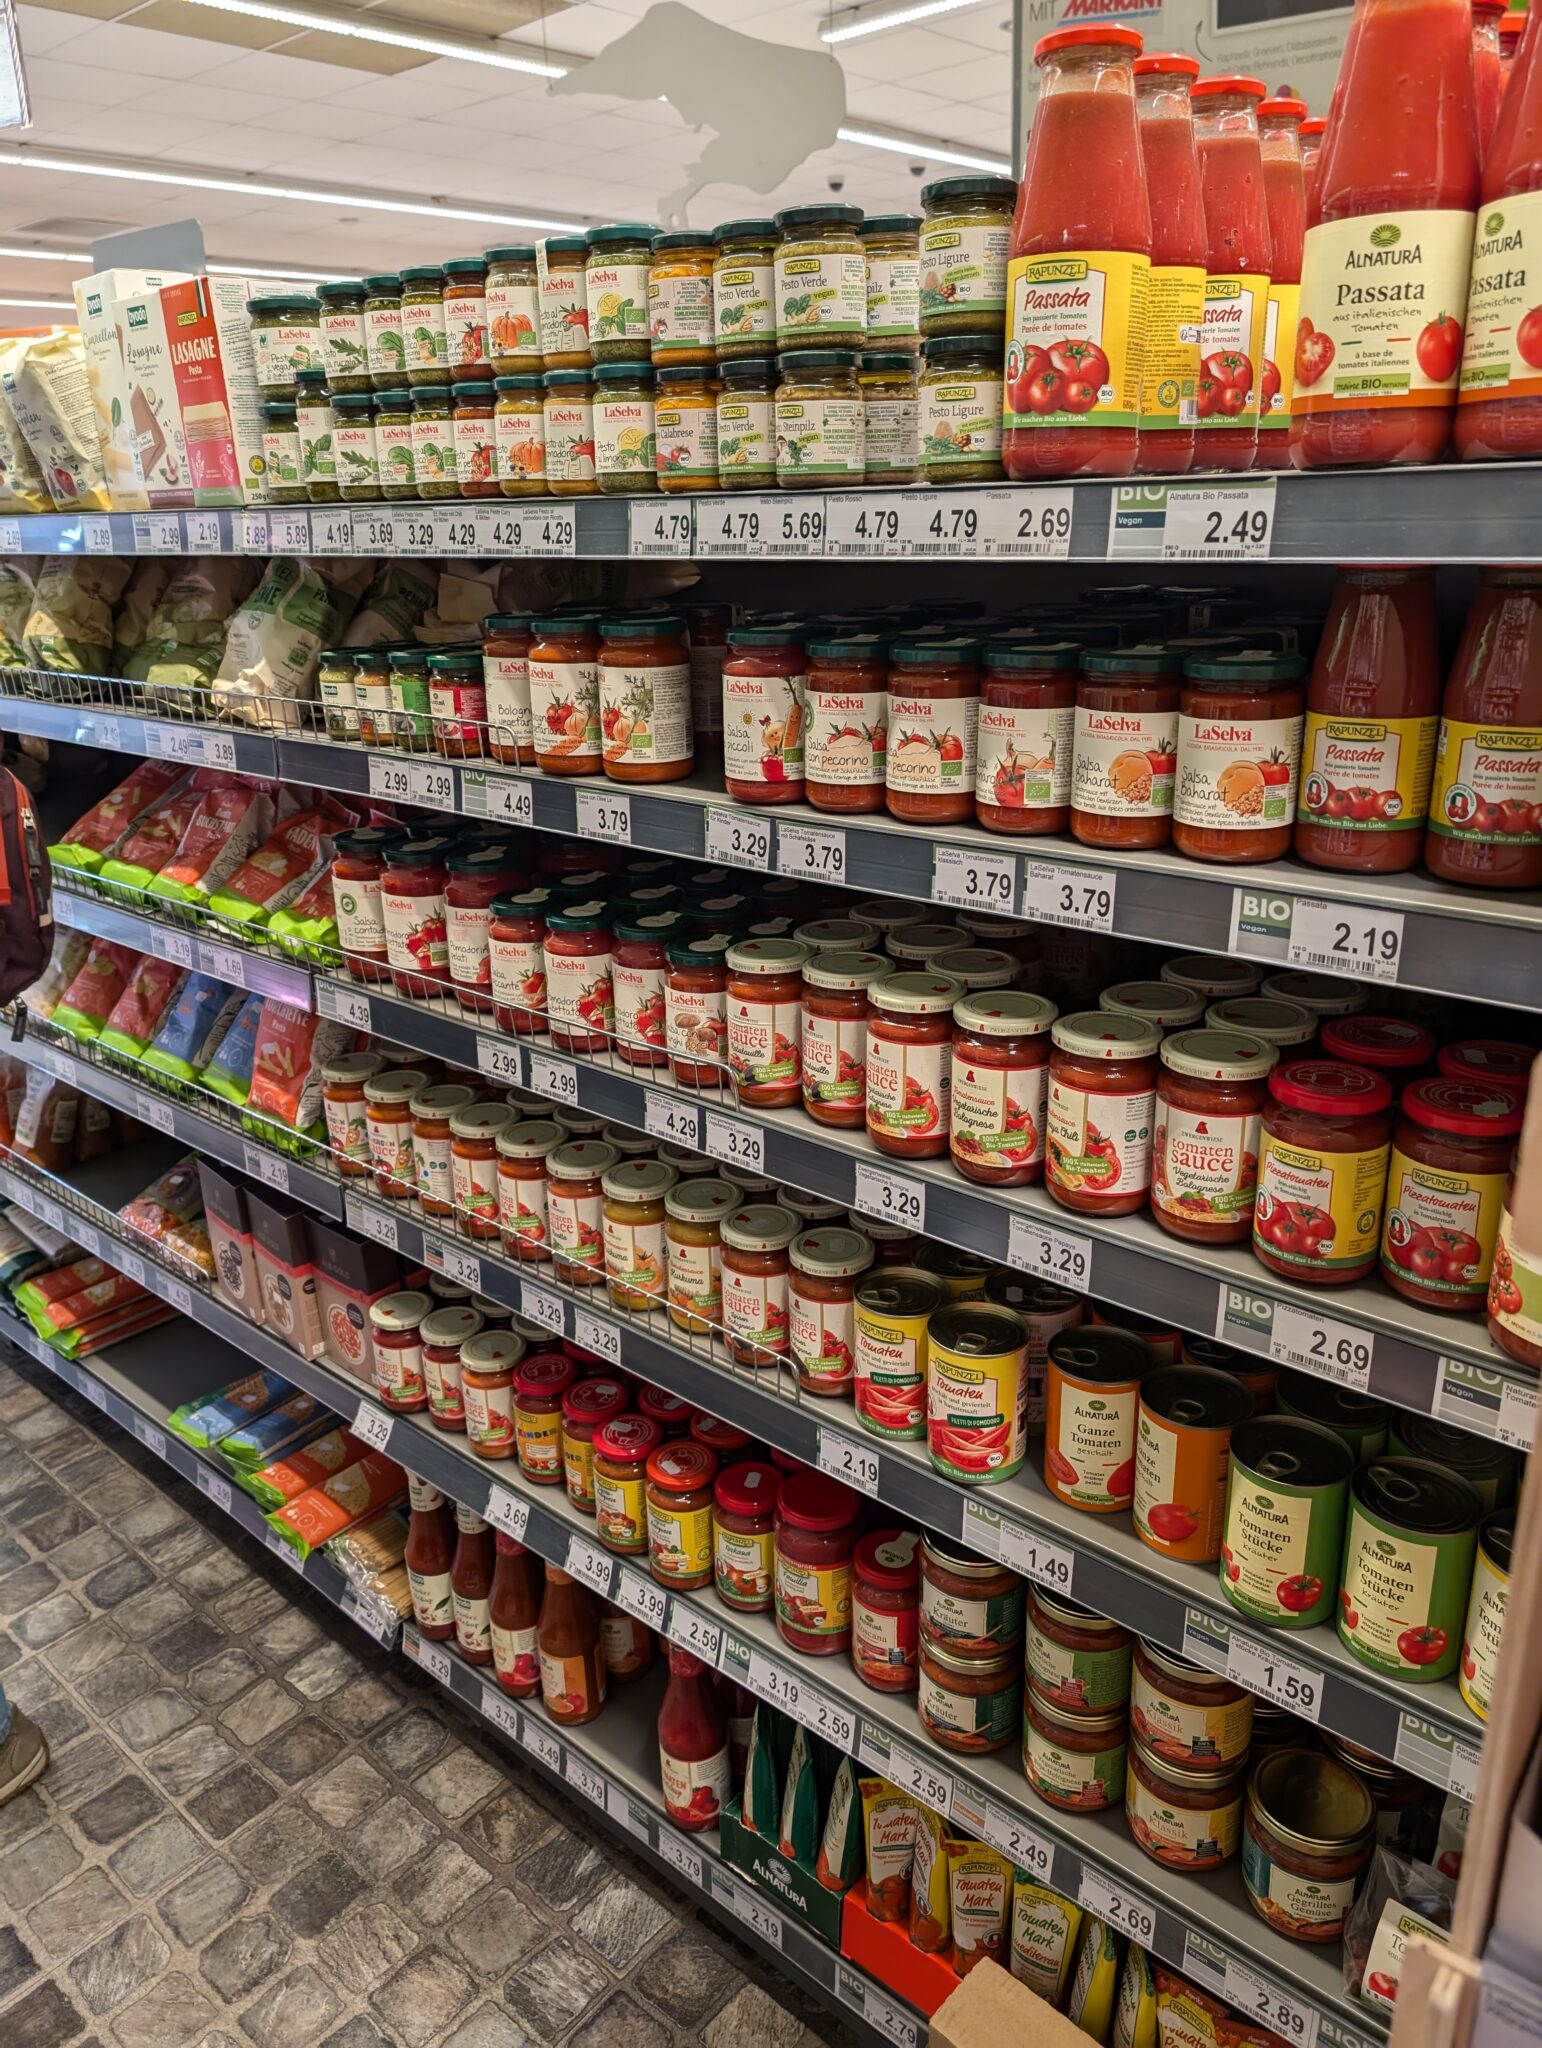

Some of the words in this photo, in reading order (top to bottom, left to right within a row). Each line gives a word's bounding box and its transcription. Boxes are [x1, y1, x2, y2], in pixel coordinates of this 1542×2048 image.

[1345, 244, 1422, 270] ALNATURA
[781, 278, 799, 289] Pesto
[800, 276, 827, 287] Verde
[813, 290, 835, 299] vegan
[1024, 288, 1090, 312] Passata
[1336, 281, 1425, 306] Passata
[746, 301, 767, 310] vegan
[1333, 310, 1351, 322] aus
[1352, 306, 1422, 320] italienischen
[1021, 323, 1041, 332] Purée
[1043, 323, 1052, 331] de
[1054, 321, 1088, 331] tomates
[1212, 334, 1240, 344] tomates
[171, 336, 217, 365] LASAGNE
[188, 365, 202, 375] Pasta
[1338, 360, 1370, 369] tomates
[1372, 357, 1410, 366] italiennes
[929, 407, 950, 418] Pesto
[952, 405, 984, 417] Ligure
[661, 428, 694, 438] Calabrese
[782, 421, 816, 432] Steinpilz
[1169, 492, 1200, 500] Alnatura
[1202, 492, 1215, 500] Bio
[1217, 491, 1249, 500] Passata
[199, 522, 218, 540] 2.19
[654, 515, 690, 540] 4.79
[722, 513, 759, 539] 4.79
[782, 512, 822, 539] 5.69
[855, 510, 899, 539] 4.79
[930, 509, 978, 539] 4.79
[1018, 508, 1071, 537] 2.69
[1118, 516, 1143, 526] Vegan
[1204, 510, 1268, 544] 2.49
[161, 527, 179, 544] 2.99
[246, 525, 266, 544] 5.89
[286, 524, 307, 544] 5.89
[327, 524, 349, 543] 4.19
[369, 523, 393, 543] 3.69
[408, 524, 434, 545] 3.29
[448, 523, 476, 545] 4.29
[493, 522, 522, 545] 4.29
[542, 521, 573, 544] 4.29
[726, 679, 763, 694] LaSelva
[818, 695, 864, 709] LaSelva
[891, 700, 932, 715] LaSelva
[727, 723, 750, 739] Salsa
[1088, 714, 1142, 731] LaSelva
[1194, 723, 1253, 741] LaSelva
[1329, 725, 1383, 738] RAPUNZEL
[215, 744, 234, 760] 3.89
[808, 753, 820, 762] con
[821, 755, 869, 767] pecorino
[1325, 744, 1384, 763] Passata
[892, 763, 936, 775] pecorino
[1076, 753, 1103, 774] Salsa
[1324, 769, 1340, 778] Purée
[1342, 770, 1350, 778] de
[1474, 754, 1541, 773] Passata
[384, 771, 407, 792] 2.99
[426, 775, 451, 796] 2.99
[1075, 771, 1120, 789] Baharat
[1182, 766, 1210, 785] Salsa
[1180, 783, 1230, 801] Baharat
[1471, 781, 1491, 789] Purée
[1505, 784, 1536, 792] tomates
[504, 793, 531, 815] 4.49
[598, 808, 628, 832] 3.79
[731, 828, 767, 857] 3.29
[804, 843, 843, 871] 3.79
[965, 869, 1012, 899] 3.79
[1060, 884, 1109, 917] 3.79
[1242, 896, 1290, 921] BIO
[1240, 923, 1267, 933] Vegan
[174, 936, 191, 956] 3.19
[1332, 922, 1398, 960] 2.19
[224, 958, 242, 974] 1.69
[349, 1003, 369, 1021] 4.39
[492, 1054, 517, 1075] 2.99
[550, 1072, 576, 1094] 2.99
[666, 1112, 696, 1138] 4.29
[1060, 1128, 1080, 1143] Chili
[728, 1133, 760, 1160] 3.29
[1181, 1131, 1223, 1143] ZWERGENWIESE
[1172, 1139, 1234, 1157] tomaten
[1274, 1148, 1320, 1169] RAPUNZEL
[1171, 1153, 1234, 1173] sauce
[271, 1166, 287, 1182] 2.19
[1173, 1166, 1230, 1184] Vegetarische
[1265, 1162, 1330, 1190] Pizzatomaten
[1414, 1171, 1466, 1193] RAPUNZEL
[1176, 1178, 1224, 1194] Bolognese
[882, 1186, 920, 1218] 3.29
[1402, 1185, 1477, 1213] Pizzatomaten
[376, 1219, 396, 1240] 3.29
[1040, 1242, 1085, 1276] 3.29
[457, 1263, 479, 1283] 3.29
[538, 1302, 561, 1324] 3.29
[1228, 1290, 1272, 1320] BIO
[1227, 1314, 1250, 1328] Vegan
[860, 1336, 903, 1359] Tomaten
[1310, 1330, 1369, 1371] 2.69
[936, 1362, 982, 1381] RAPUNZEL
[936, 1377, 983, 1400] Tomaten
[1445, 1382, 1474, 1400] Vegan
[961, 1399, 991, 1409] geviertelt
[1075, 1406, 1119, 1422] ALNATURA
[1070, 1432, 1121, 1448] Tomaten
[1077, 1423, 1115, 1438] Ganze
[1077, 1447, 1114, 1458] geschält
[843, 1451, 878, 1482] 2.19
[504, 1504, 527, 1528] 3.69
[1242, 1497, 1289, 1526] ALNATURA
[1237, 1511, 1291, 1544] Tomaten
[1241, 1529, 1283, 1554] Stücke
[585, 1555, 610, 1580] 3.99
[1028, 1549, 1069, 1583] 1.49
[1362, 1541, 1412, 1574] ALNATURA
[1357, 1555, 1414, 1593] Tomaten
[1360, 1576, 1405, 1604] Stücke
[1362, 1590, 1400, 1611] Kräuter
[639, 1589, 664, 1617] 3.99
[933, 1608, 969, 1628] Kräuter
[691, 1622, 718, 1651] 2.59
[727, 1640, 750, 1660] BIO
[430, 1655, 449, 1679] 5.29
[769, 1673, 798, 1703] 3.19
[1263, 1666, 1315, 1707] 1.59
[495, 1705, 515, 1730] 3.79
[926, 1703, 958, 1722] Kräuter
[1146, 1709, 1184, 1734] Klassik
[818, 1708, 850, 1740] 2.59
[538, 1739, 559, 1765] 3.49
[911, 1776, 947, 1803] 2.59
[880, 1827, 910, 1843] Mark
[1149, 1818, 1190, 1840] Klassik
[1009, 1832, 1048, 1869] 2.49
[676, 1849, 700, 1877] 3.79
[752, 1858, 808, 1912] ALNATURA
[955, 1879, 1002, 1894] Tomaten
[963, 1891, 995, 1909] Mark
[1287, 1892, 1337, 1910] Gegrilltes
[1290, 1904, 1332, 1917] Gemüse
[751, 1908, 779, 1938] 2.19
[1015, 1908, 1065, 1938] Tomaten
[1108, 1902, 1152, 1934] 2.69
[1022, 1925, 1055, 1950] Mark
[1256, 1993, 1305, 2035] 2.89
[885, 2011, 916, 2046] 2.79
